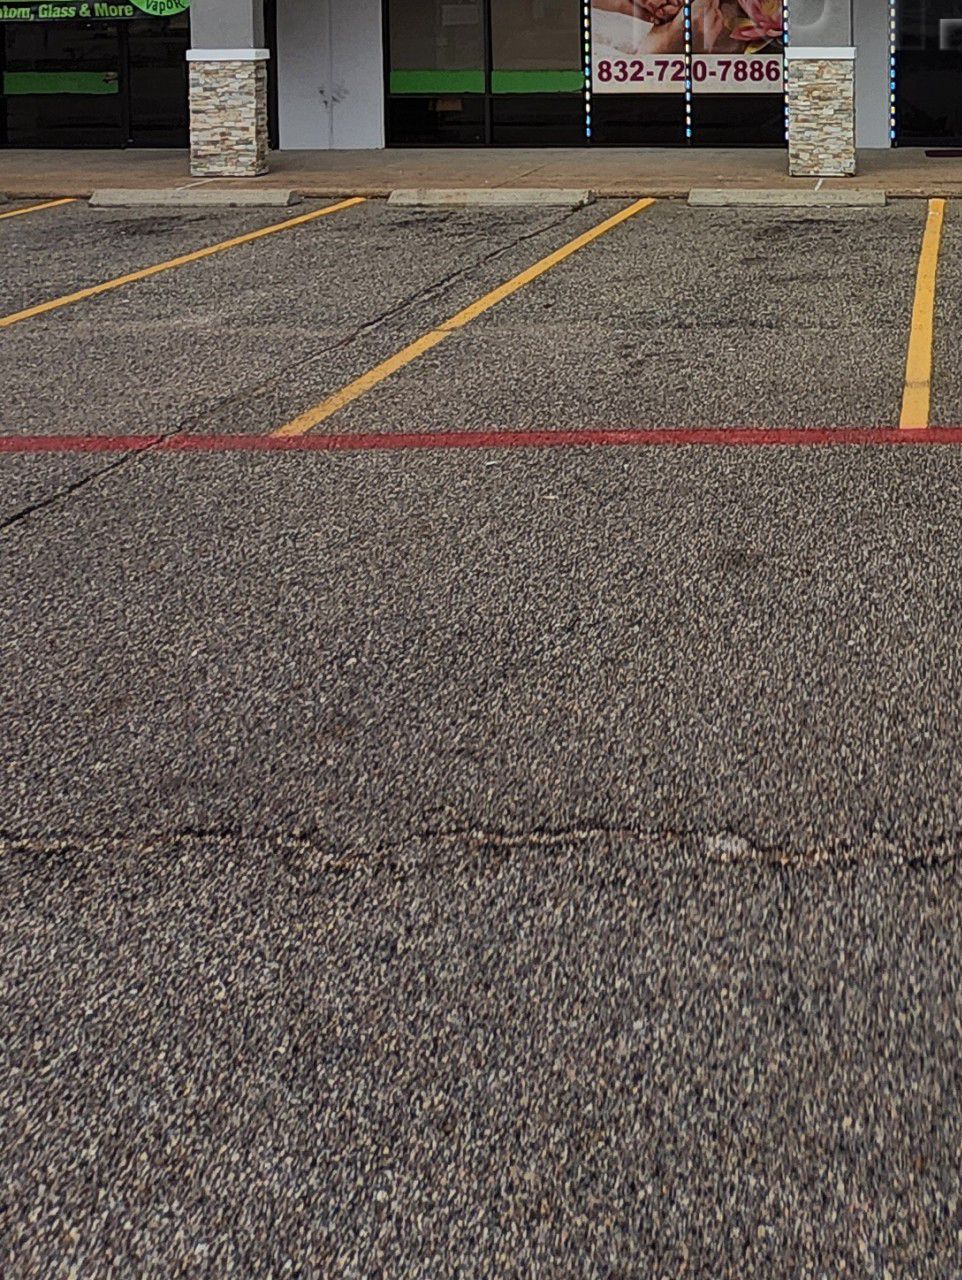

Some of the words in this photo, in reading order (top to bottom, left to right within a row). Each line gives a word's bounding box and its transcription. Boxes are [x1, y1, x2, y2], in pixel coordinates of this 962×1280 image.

[39, 4, 77, 19] Glass
[80, 3, 91, 18] &
[95, 2, 134, 18] More
[597, 59, 781, 83] 832-720-7886
